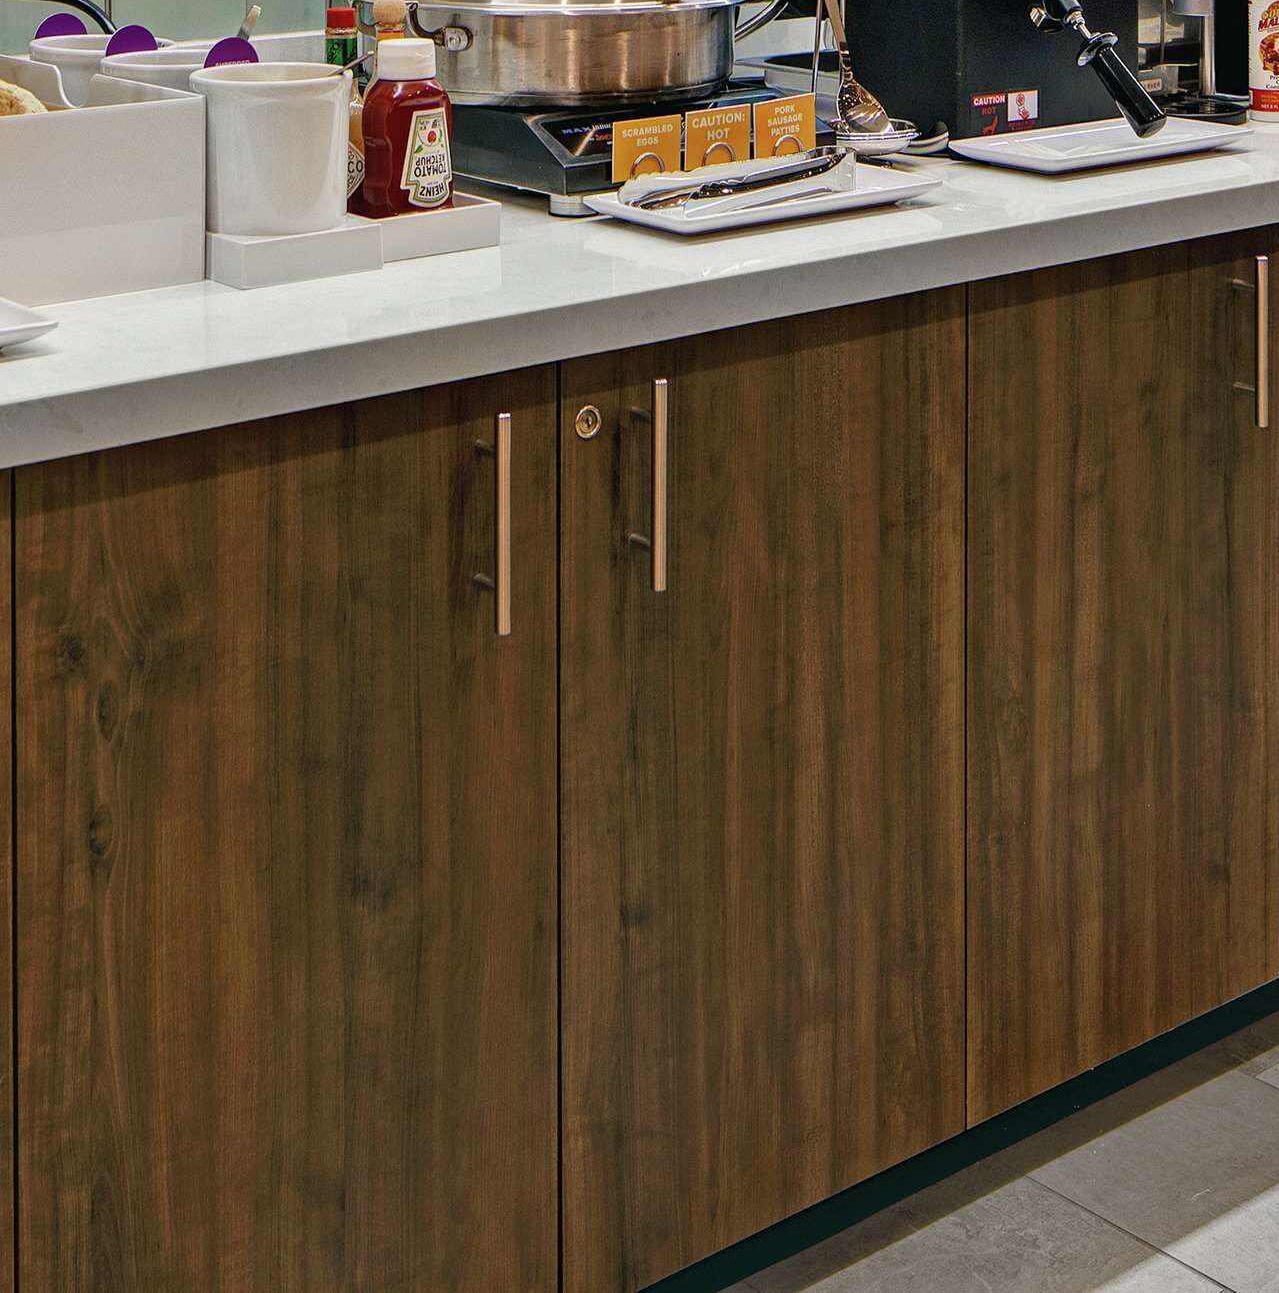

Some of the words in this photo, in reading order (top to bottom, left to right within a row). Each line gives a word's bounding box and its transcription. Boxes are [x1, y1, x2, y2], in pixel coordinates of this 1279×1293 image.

[973, 94, 1006, 107] CAUTION
[774, 104, 796, 115] PORK
[981, 106, 997, 116] HOT
[691, 110, 745, 129] CAUTION:
[767, 113, 803, 127] SAUSAGE
[621, 124, 674, 139] SCRAMBLED
[707, 127, 730, 141] HOT
[771, 124, 801, 137] PATTIES
[636, 136, 660, 147] EGGS
[416, 153, 446, 167] KETCHUP
[414, 162, 447, 178] TOMATO
[419, 182, 445, 197] HEINZ
